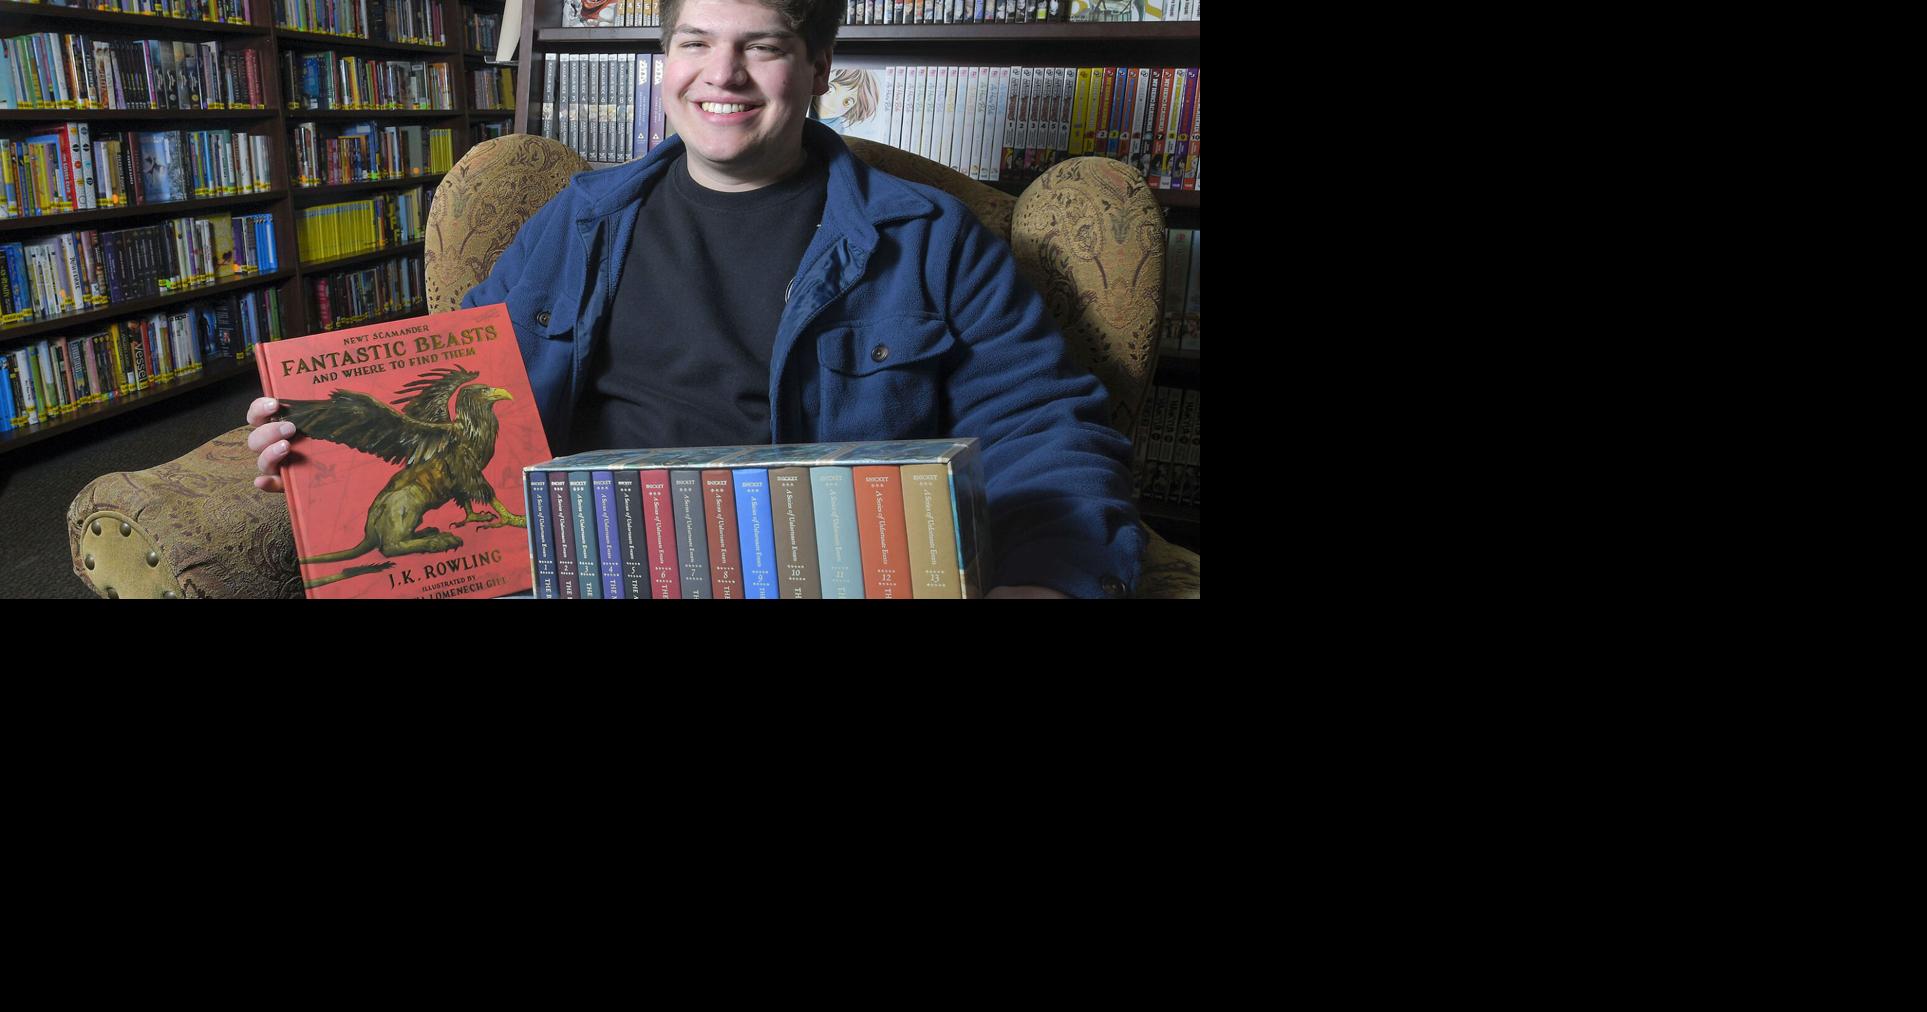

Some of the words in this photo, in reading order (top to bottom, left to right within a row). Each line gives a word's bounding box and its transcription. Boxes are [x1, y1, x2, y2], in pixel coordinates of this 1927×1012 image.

[344, 335, 369, 346] NEWT
[372, 324, 429, 340] SCAMANDER
[281, 341, 407, 377] FANTASTIC
[415, 325, 498, 353] BEASTS
[135, 343, 147, 382] Vessel
[312, 372, 338, 385] AND
[342, 364, 386, 378] WHERE
[389, 360, 405, 370] TO
[409, 354, 439, 367] FIND
[442, 348, 476, 361] THEM
[388, 569, 421, 589] J.K.
[424, 550, 502, 579] ROWLING
[585, 565, 589, 573] 3
[631, 566, 636, 574] 5
[691, 569, 696, 577] 7
[723, 571, 728, 579] 8
[422, 577, 465, 592] ILLUSTRATED
[931, 574, 940, 582] 13
[565, 580, 573, 595] THE
[631, 579, 639, 594] THE
[661, 584, 669, 599] THE
